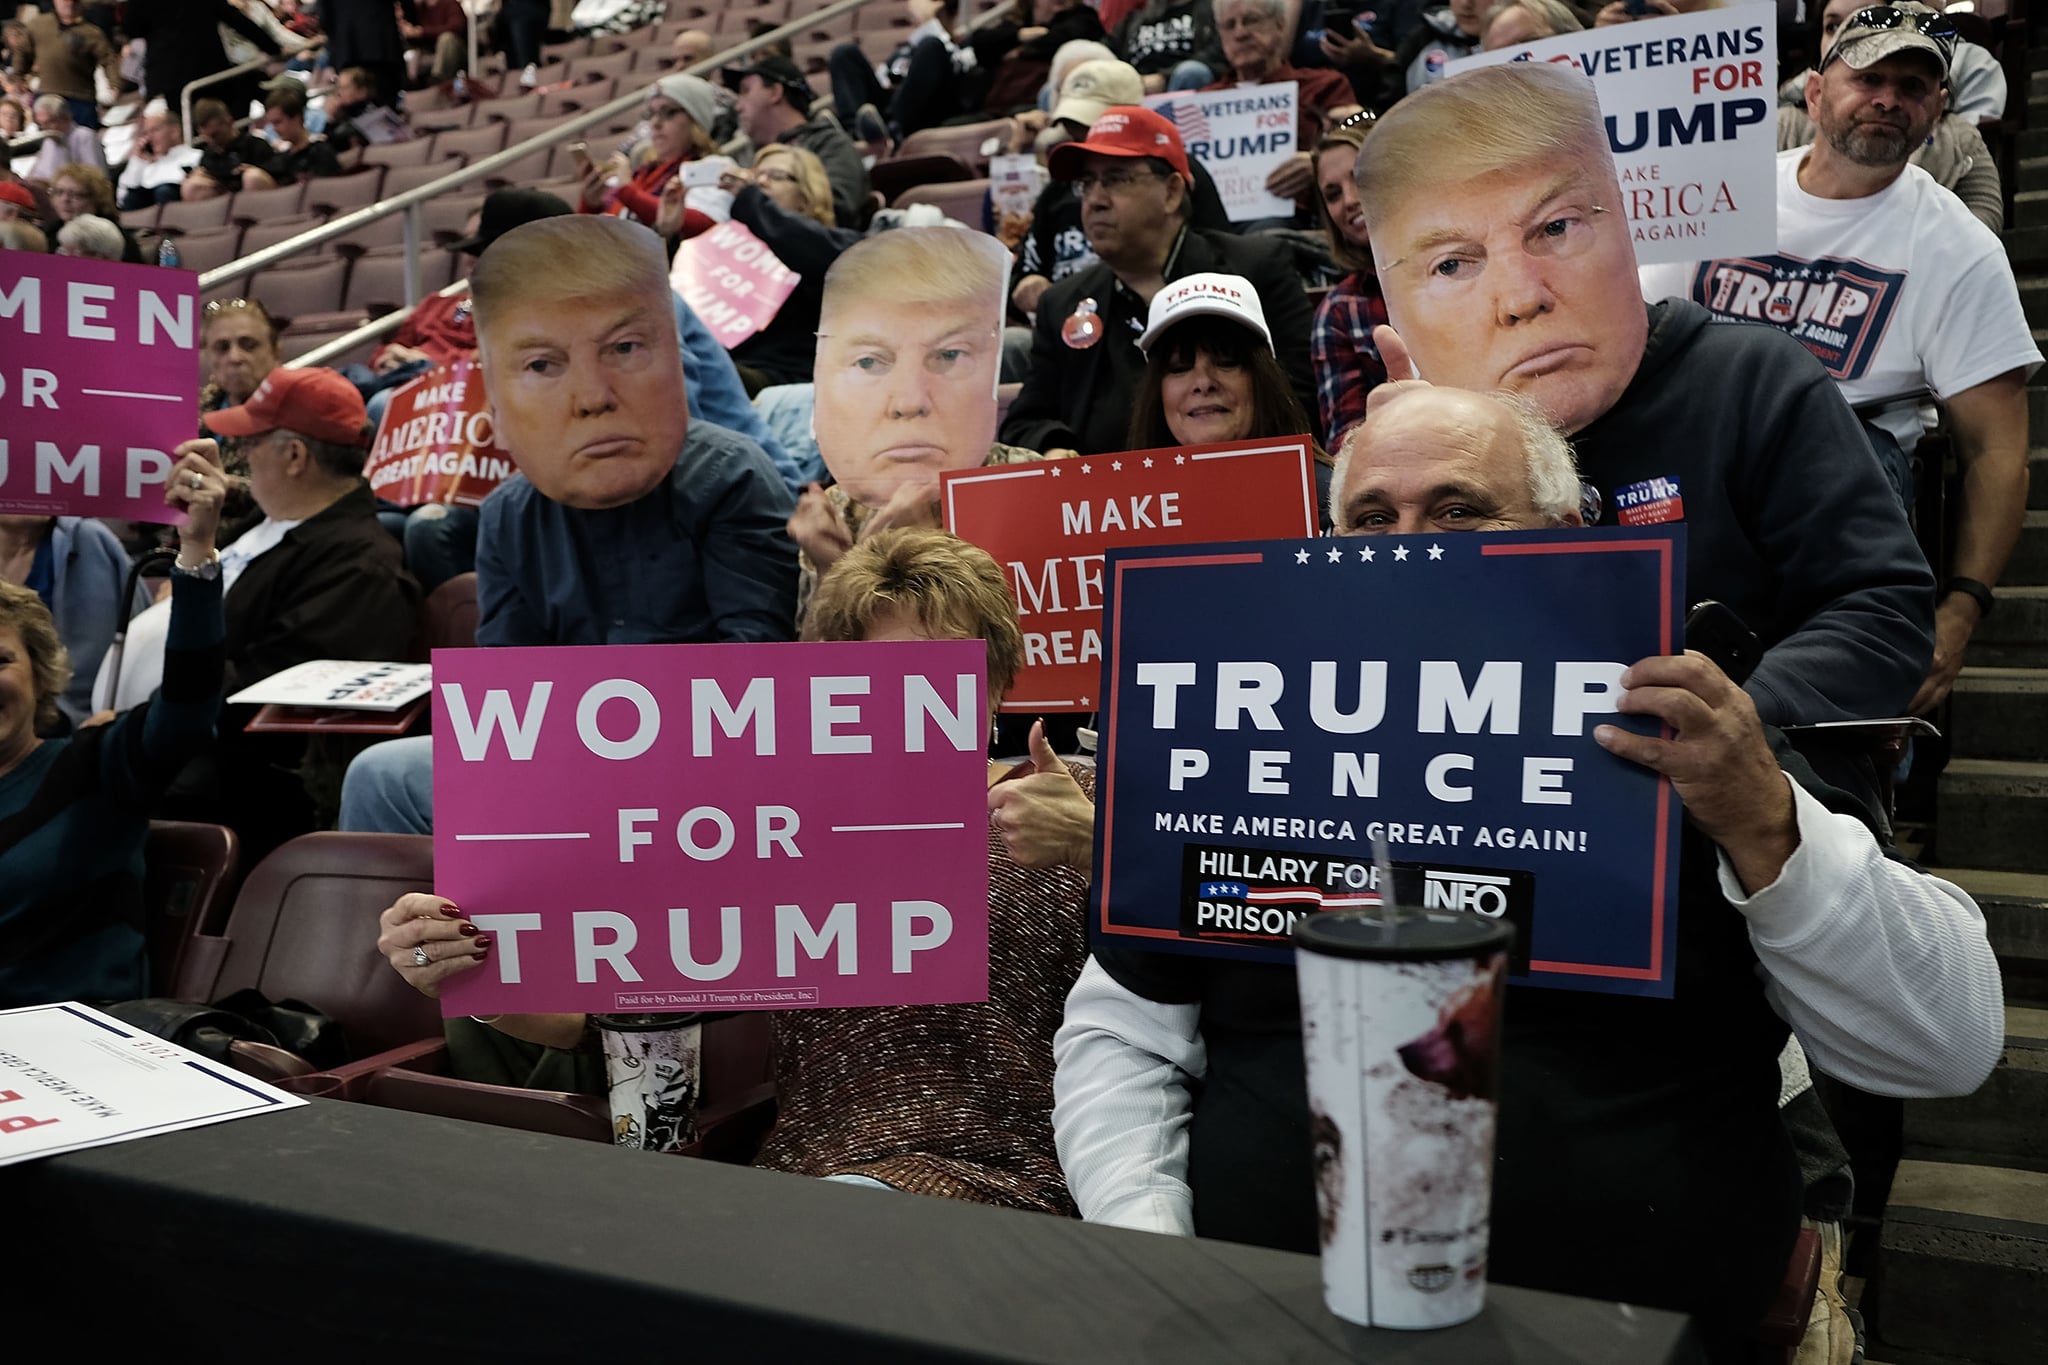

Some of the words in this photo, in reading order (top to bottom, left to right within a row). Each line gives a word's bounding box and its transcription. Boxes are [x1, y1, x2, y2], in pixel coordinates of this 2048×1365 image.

[1580, 26, 1764, 77] VETERANS
[1693, 60, 1763, 95] FOR
[1201, 94, 1291, 118] VETERANS
[1256, 112, 1290, 129] FOR
[1184, 131, 1291, 161] RUMP
[1634, 222, 1707, 242] AGAIN!
[1166, 283, 1242, 303] TRUMP
[1711, 267, 1870, 329] TRUMP
[0, 368, 60, 409] R
[412, 381, 468, 411] MAKE
[0, 439, 174, 498] MP
[1616, 483, 1679, 507] TRUMP
[1061, 492, 1183, 536] MAKE
[1136, 661, 1630, 736] TRUMP
[440, 674, 978, 761] WOMEN
[1169, 748, 1574, 805] PENCE
[618, 805, 804, 863] FOR
[1155, 812, 1224, 834] MAKE
[1232, 817, 1356, 842] AMERICA
[1366, 821, 1464, 847] GREAT
[1474, 828, 1588, 853] AGAIN!
[1200, 851, 1319, 884] HILLARY
[1424, 880, 1508, 919] INFO
[469, 900, 954, 984] TRUMP
[619, 996, 639, 1005] Paid
[640, 995, 654, 1005] for
[655, 994, 666, 1006] by
[668, 993, 700, 1004] Donald
[709, 993, 736, 1005] Trump
[739, 992, 753, 1002] for
[798, 991, 815, 1001] Inc.
[18, 1067, 86, 1096] AMERICA
[69, 1094, 123, 1118] MAKE
